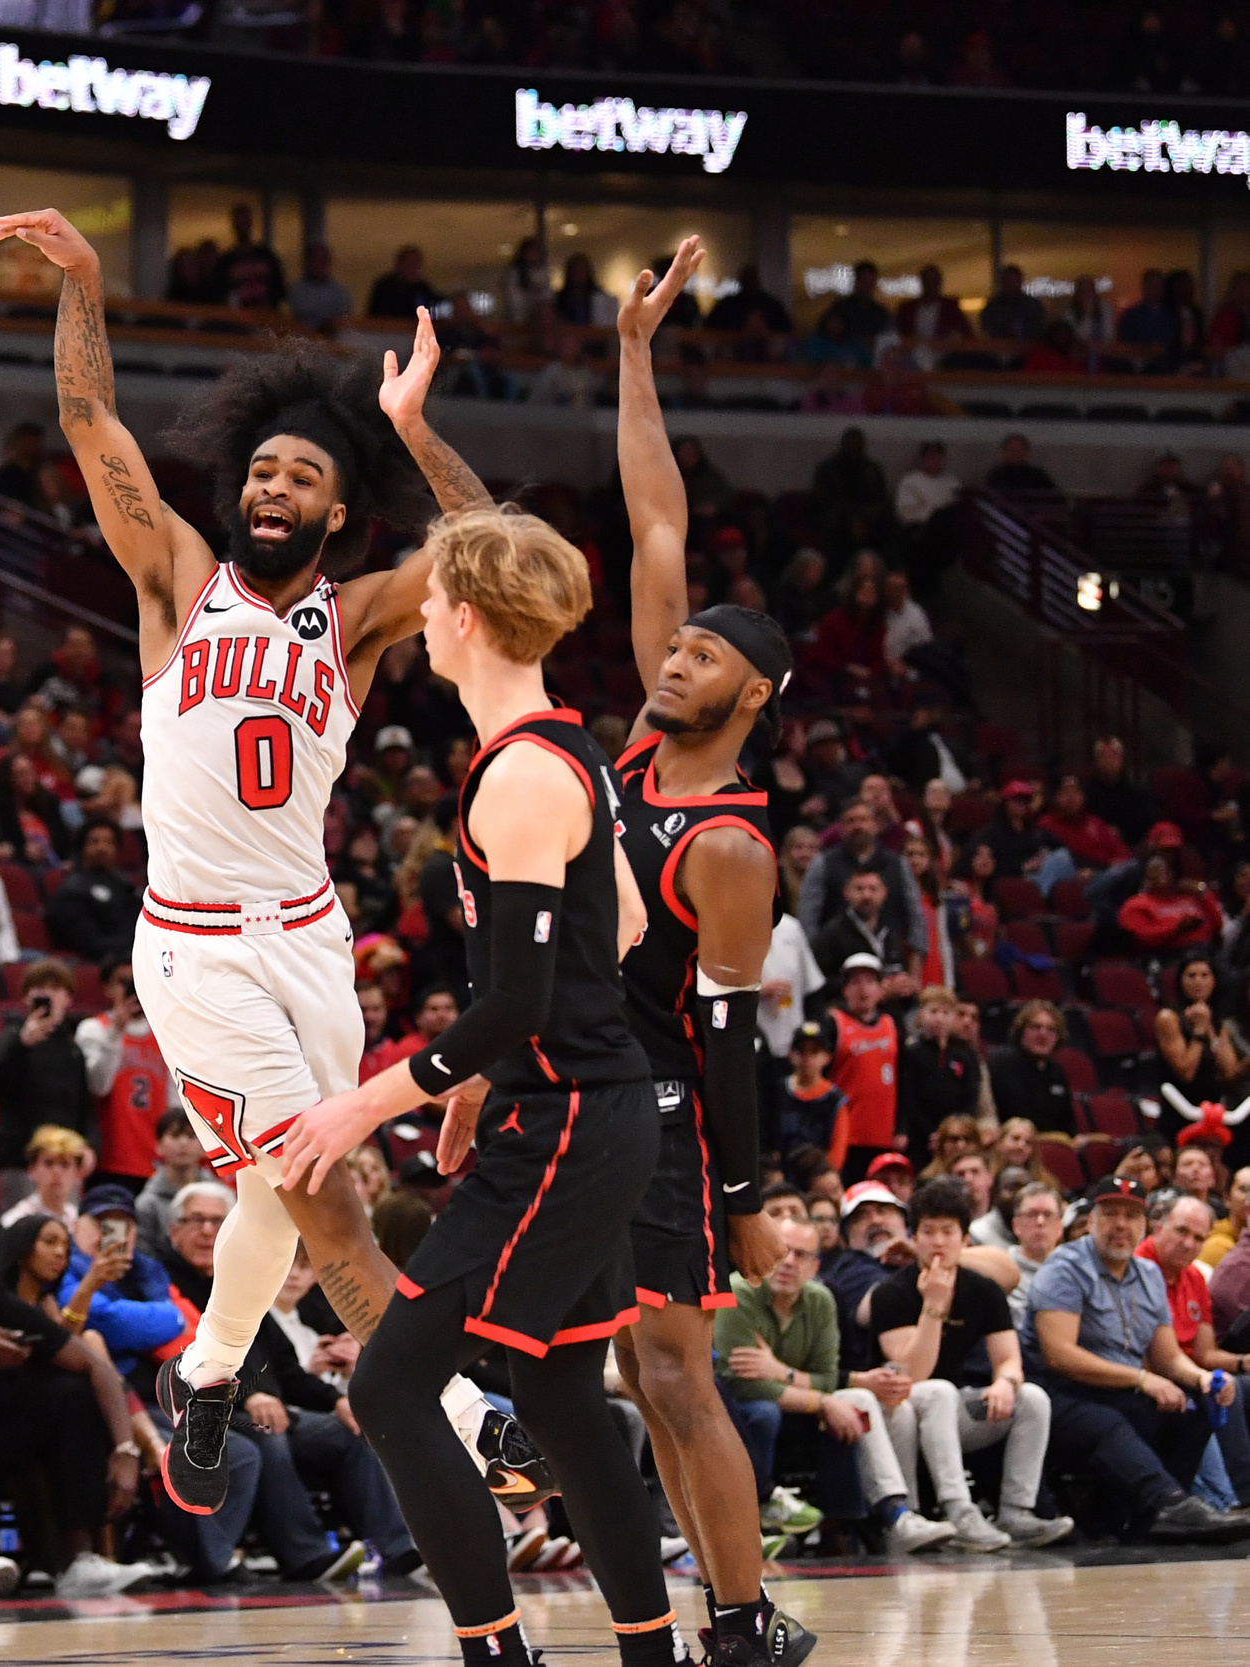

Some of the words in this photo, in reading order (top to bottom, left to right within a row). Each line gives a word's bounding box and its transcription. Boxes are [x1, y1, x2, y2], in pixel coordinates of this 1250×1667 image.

[515, 88, 748, 173] betway
[1065, 111, 1250, 191] betwa
[178, 636, 335, 738] BULLS
[234, 714, 294, 812] 0
[130, 1075, 149, 1109] 2
